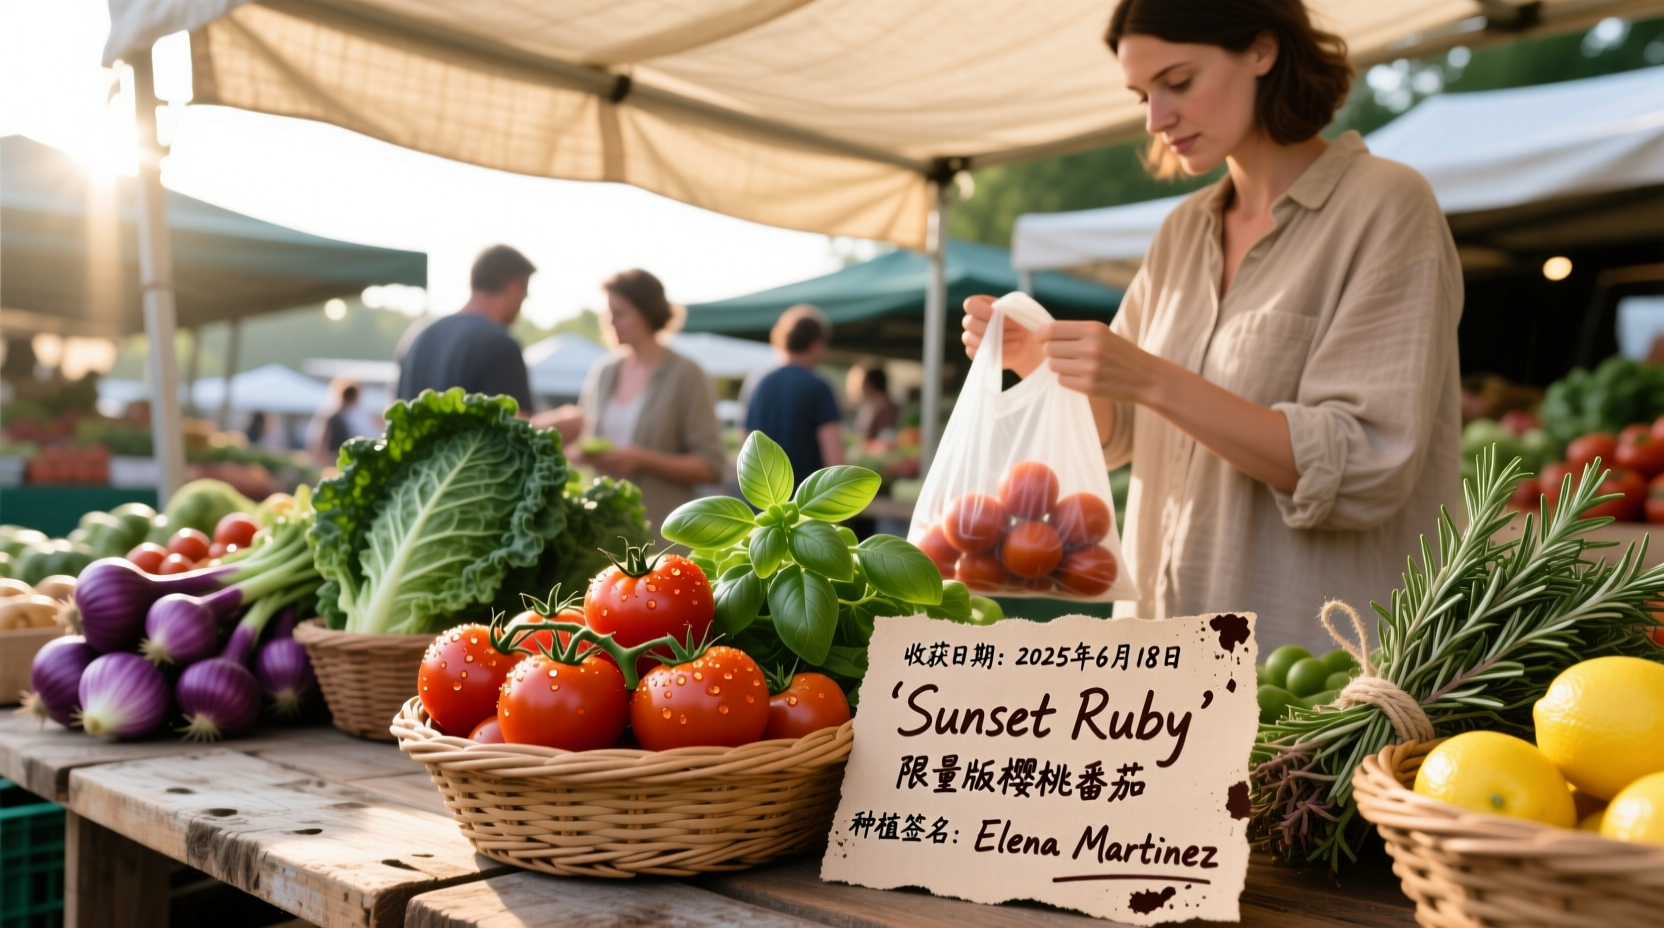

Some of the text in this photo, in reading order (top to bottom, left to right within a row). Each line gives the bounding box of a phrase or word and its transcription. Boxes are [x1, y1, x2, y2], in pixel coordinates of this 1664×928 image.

[896, 754, 1145, 802] 限量版樱桃番茄
[974, 819, 1060, 856] Elena
[1072, 825, 1218, 868] Martinez
